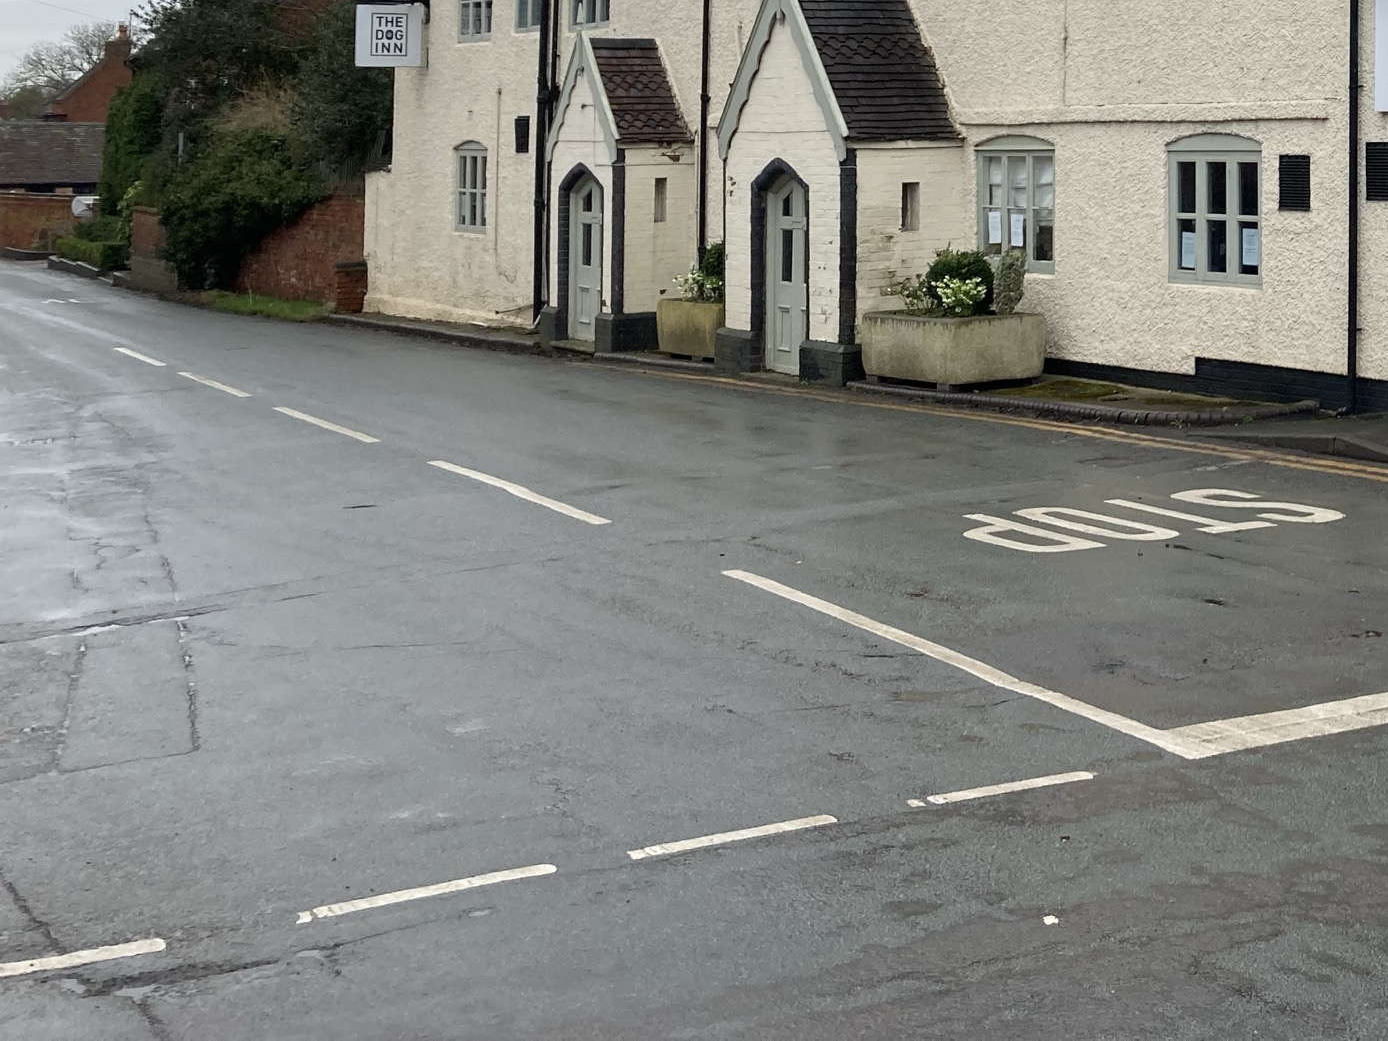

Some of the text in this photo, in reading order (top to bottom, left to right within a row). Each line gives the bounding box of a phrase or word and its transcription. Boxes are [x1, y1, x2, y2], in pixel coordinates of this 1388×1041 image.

[375, 16, 404, 28] THE
[375, 29, 404, 41] DOG
[375, 42, 403, 54] INN
[962, 487, 1347, 553] STOP
